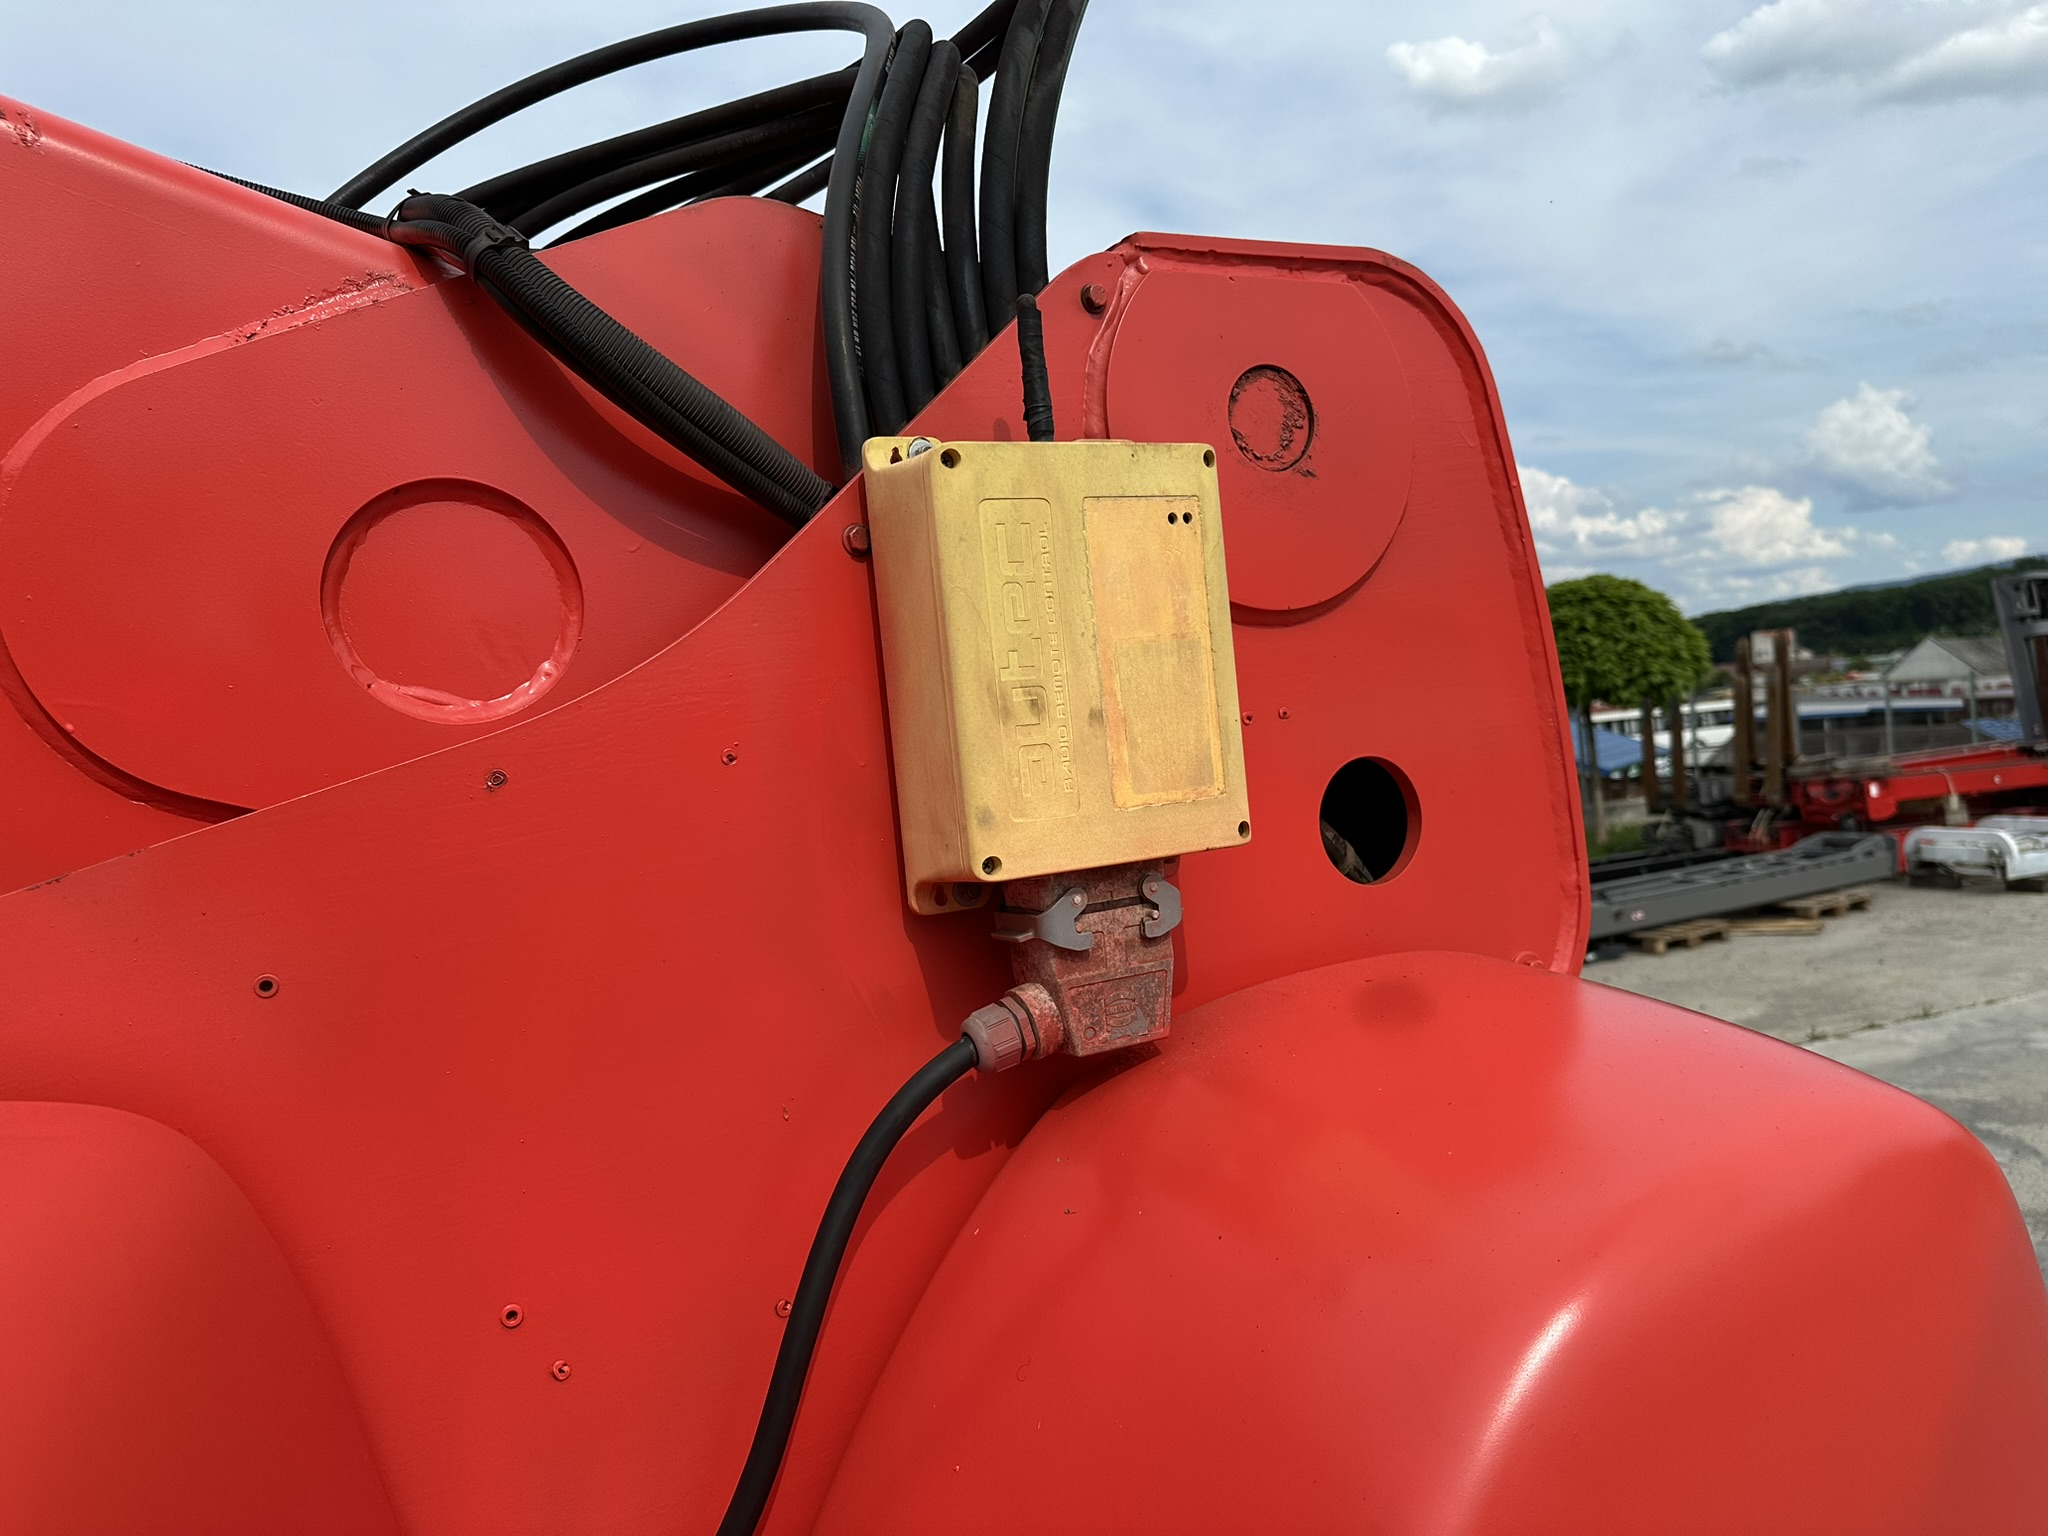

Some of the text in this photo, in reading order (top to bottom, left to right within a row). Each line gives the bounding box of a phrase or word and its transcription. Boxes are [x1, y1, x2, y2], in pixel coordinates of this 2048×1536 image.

[994, 522, 1057, 798] autec
[1038, 522, 1074, 793] RADIO REMOTE CONTROL
